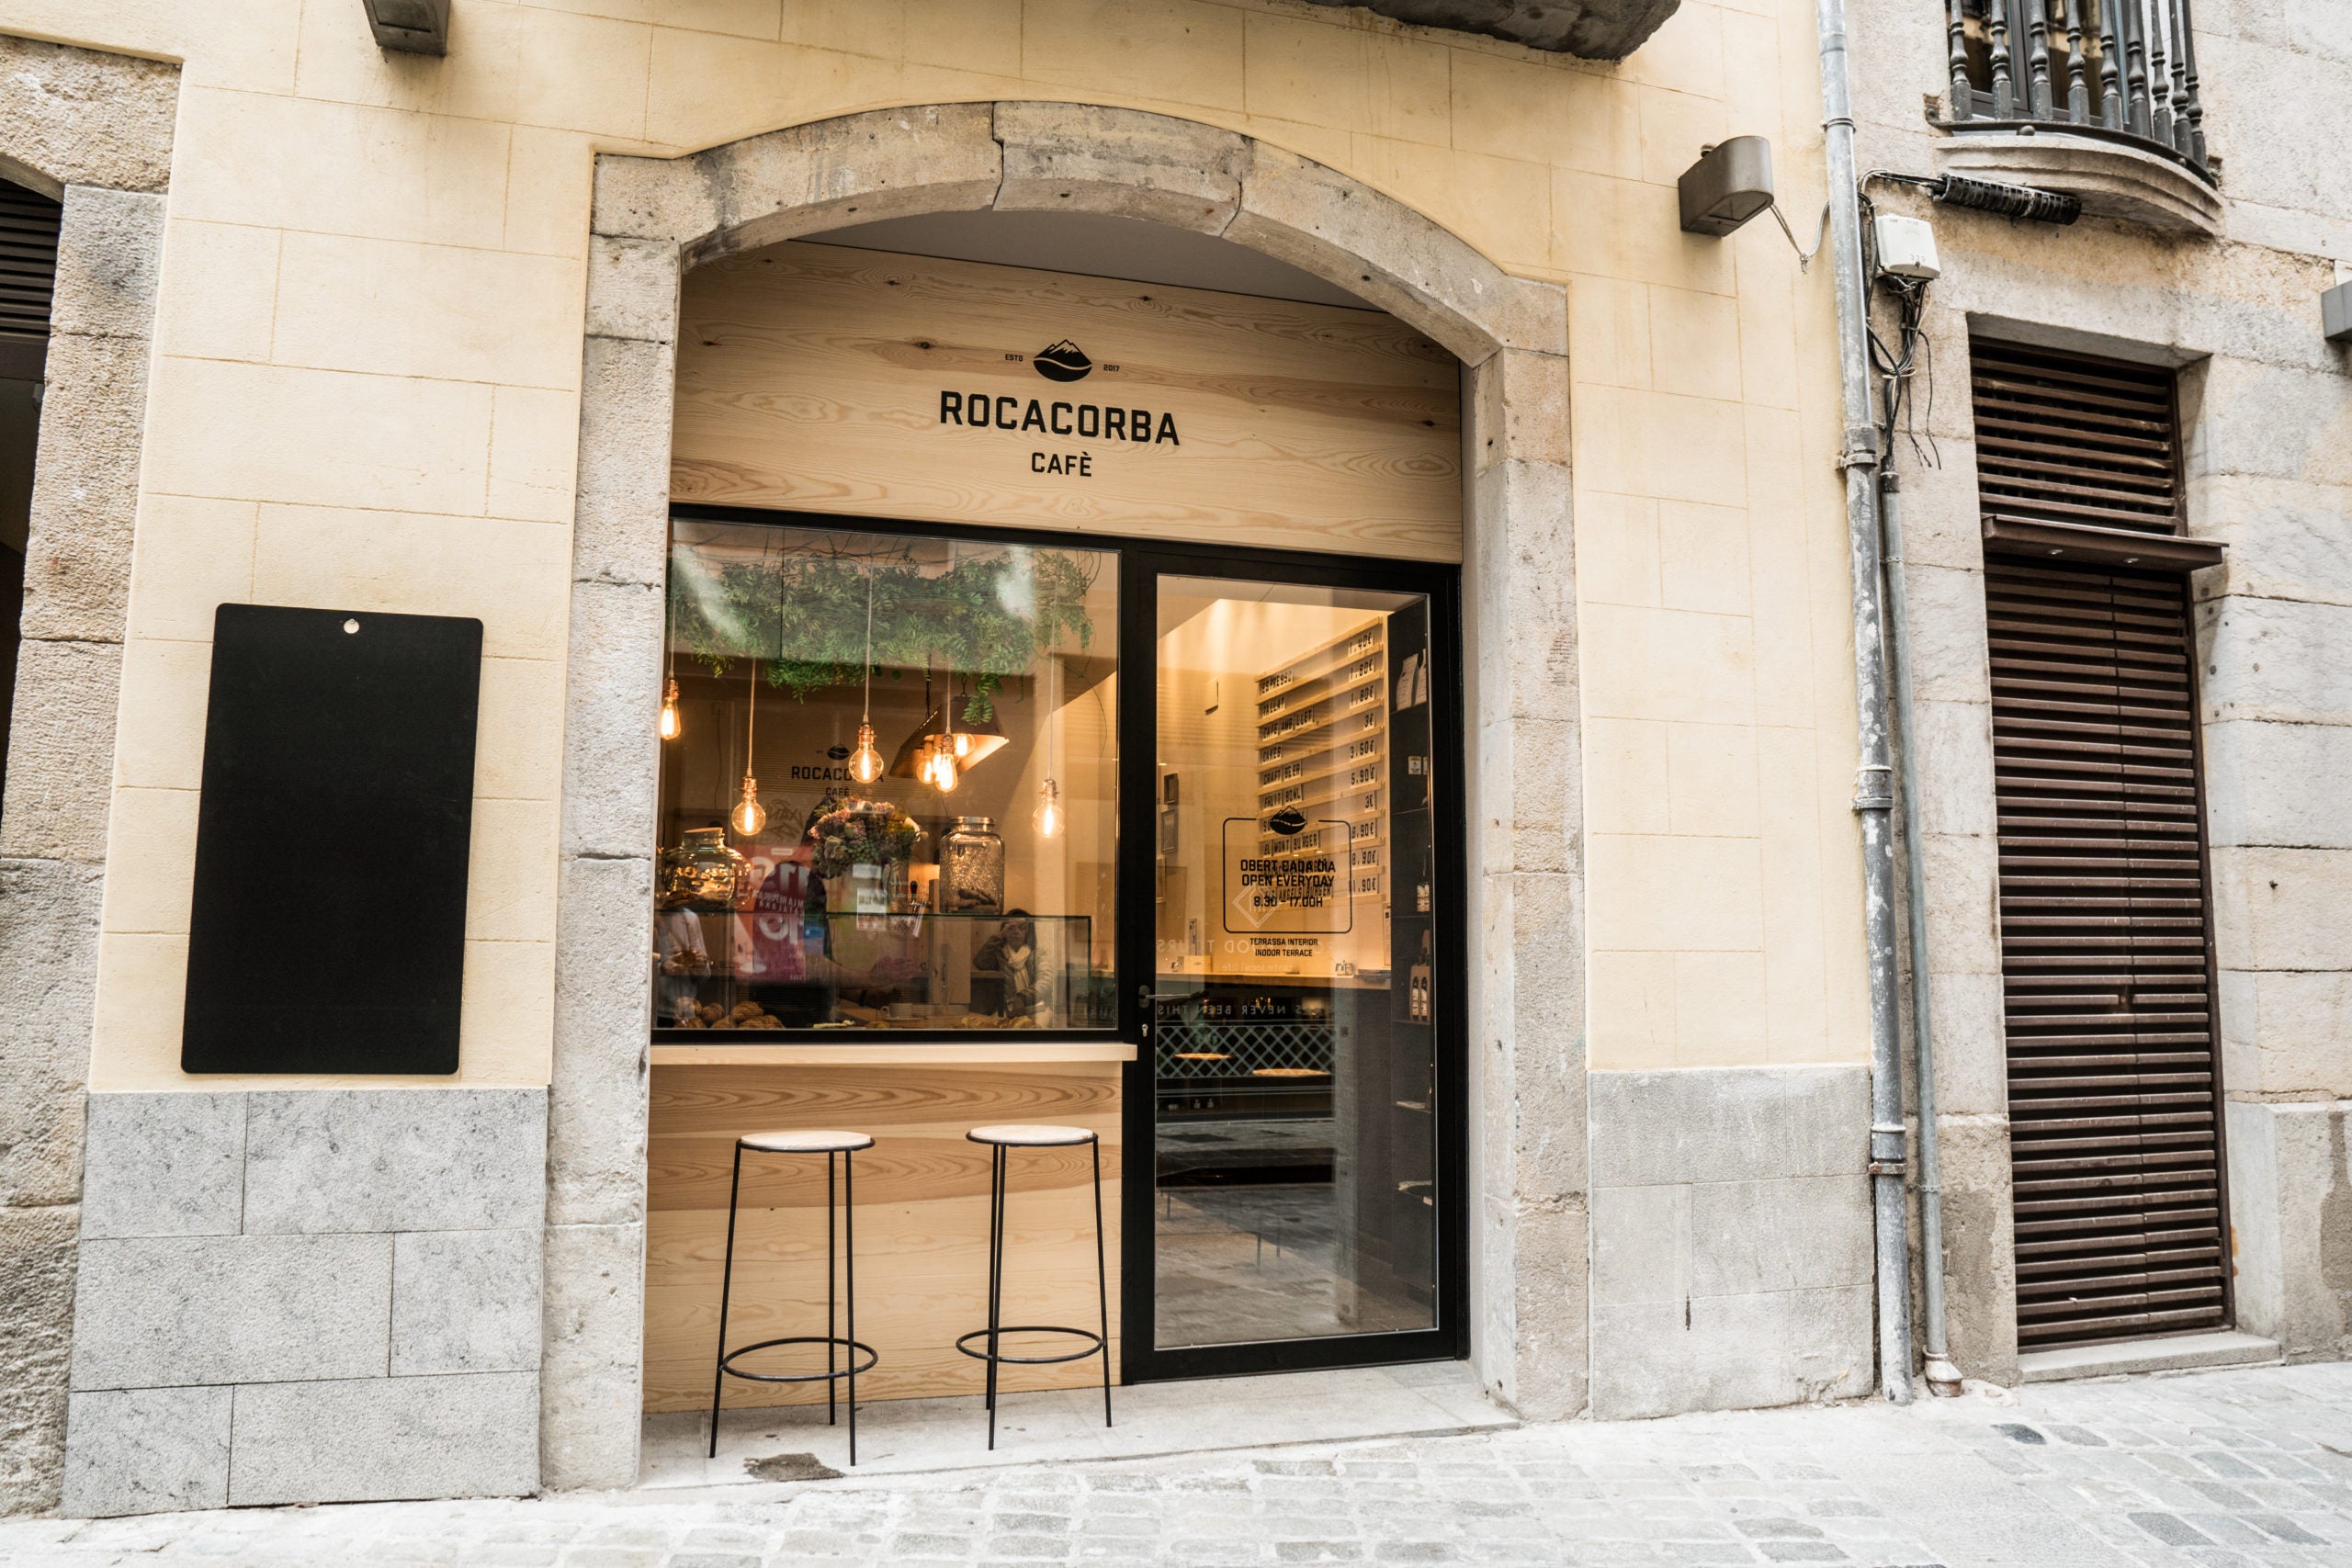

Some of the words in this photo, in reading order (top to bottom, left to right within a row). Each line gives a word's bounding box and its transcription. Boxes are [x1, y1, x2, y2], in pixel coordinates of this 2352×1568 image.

[1102, 364, 1120, 372] 2017
[940, 390, 1181, 446] ROCACORBA
[1031, 451, 1092, 478] CAFÈ
[1261, 670, 1293, 694] ESPRESSO
[1349, 632, 1373, 656] 1.40€
[1263, 696, 1285, 716] TALLAT
[1262, 746, 1282, 762] CAKES
[1364, 713, 1374, 728] 3€
[1263, 769, 1281, 785] CRAFT
[1284, 763, 1301, 779] BEER
[1350, 739, 1374, 759] 3.50€
[791, 766, 884, 783] ROCACOA
[1264, 792, 1281, 807] FRUIT
[1285, 787, 1301, 803] BOWL
[1351, 767, 1375, 785] 5.90€
[1364, 794, 1374, 808] 3€
[1273, 840, 1289, 853] MONT
[1294, 833, 1317, 851] BURGER
[1351, 822, 1374, 839] 8.90€
[1240, 859, 1278, 872] OBERT
[1282, 860, 1313, 873] CADA
[1351, 850, 1376, 866] 8.90€
[1242, 874, 1272, 886] OPEN
[1276, 874, 1335, 887] EVERYDAY
[1349, 877, 1376, 893] 1.90€
[1253, 896, 1278, 908] 8.30
[1289, 896, 1323, 908] 17.00H
[1250, 938, 1285, 946] TERRASSA
[1287, 938, 1318, 946] INTERIOR
[1255, 949, 1280, 957] INDOOR
[1283, 949, 1313, 957] TERRACE
